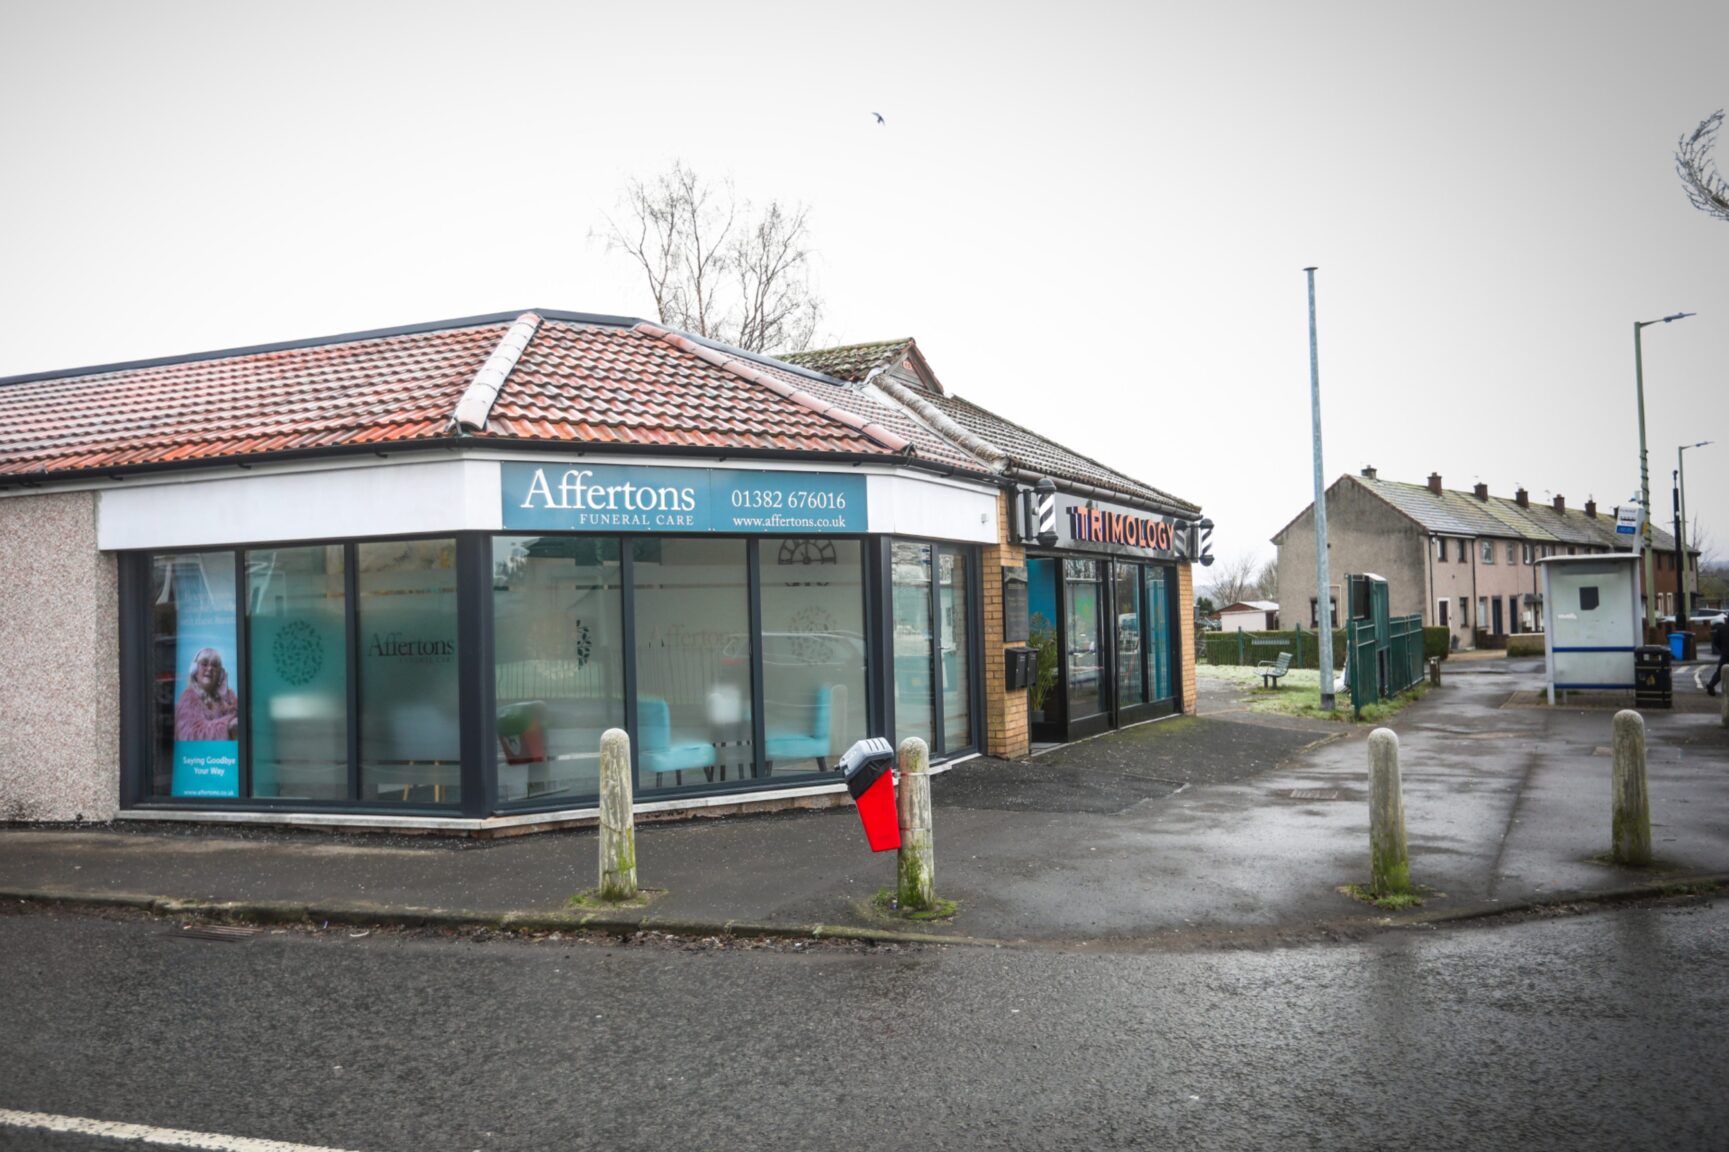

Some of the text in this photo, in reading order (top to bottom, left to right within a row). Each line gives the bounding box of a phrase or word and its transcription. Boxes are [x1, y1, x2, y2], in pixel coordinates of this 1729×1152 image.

[520, 467, 696, 512] Affertons
[730, 489, 847, 511] 01382 676016
[579, 512, 695, 527] FUNERAL CARE
[732, 514, 847, 530] www.affertons.co.uk
[1072, 506, 1174, 550] TRIMOLOGY
[367, 631, 456, 657] Affertons
[647, 623, 739, 649] Afferto
[183, 756, 236, 766] Saying Goodbye
[194, 767, 224, 777] Your Way
